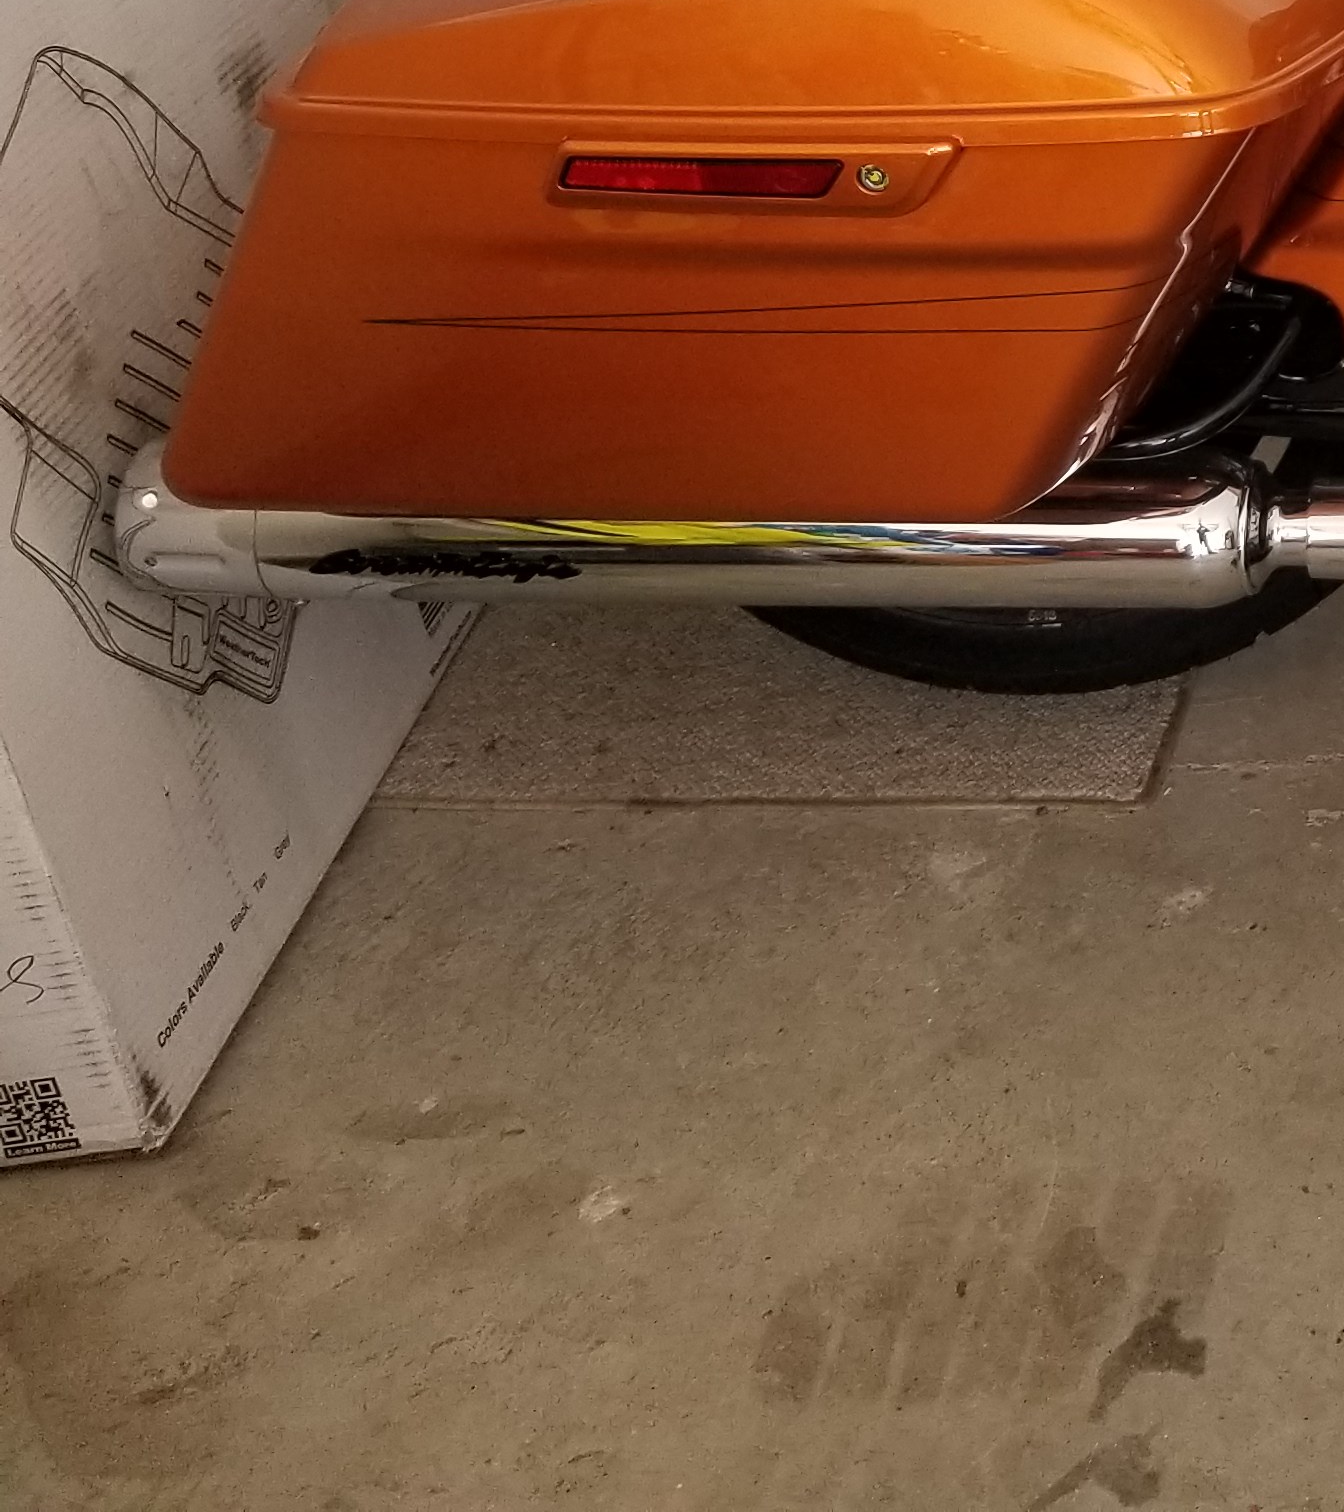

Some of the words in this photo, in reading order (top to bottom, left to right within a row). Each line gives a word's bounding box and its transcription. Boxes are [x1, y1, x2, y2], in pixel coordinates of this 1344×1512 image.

[157, 1002, 188, 1048] Colors
[187, 941, 224, 1004] Available
[7, 1146, 44, 1157] Learn
[46, 1142, 77, 1152] More
